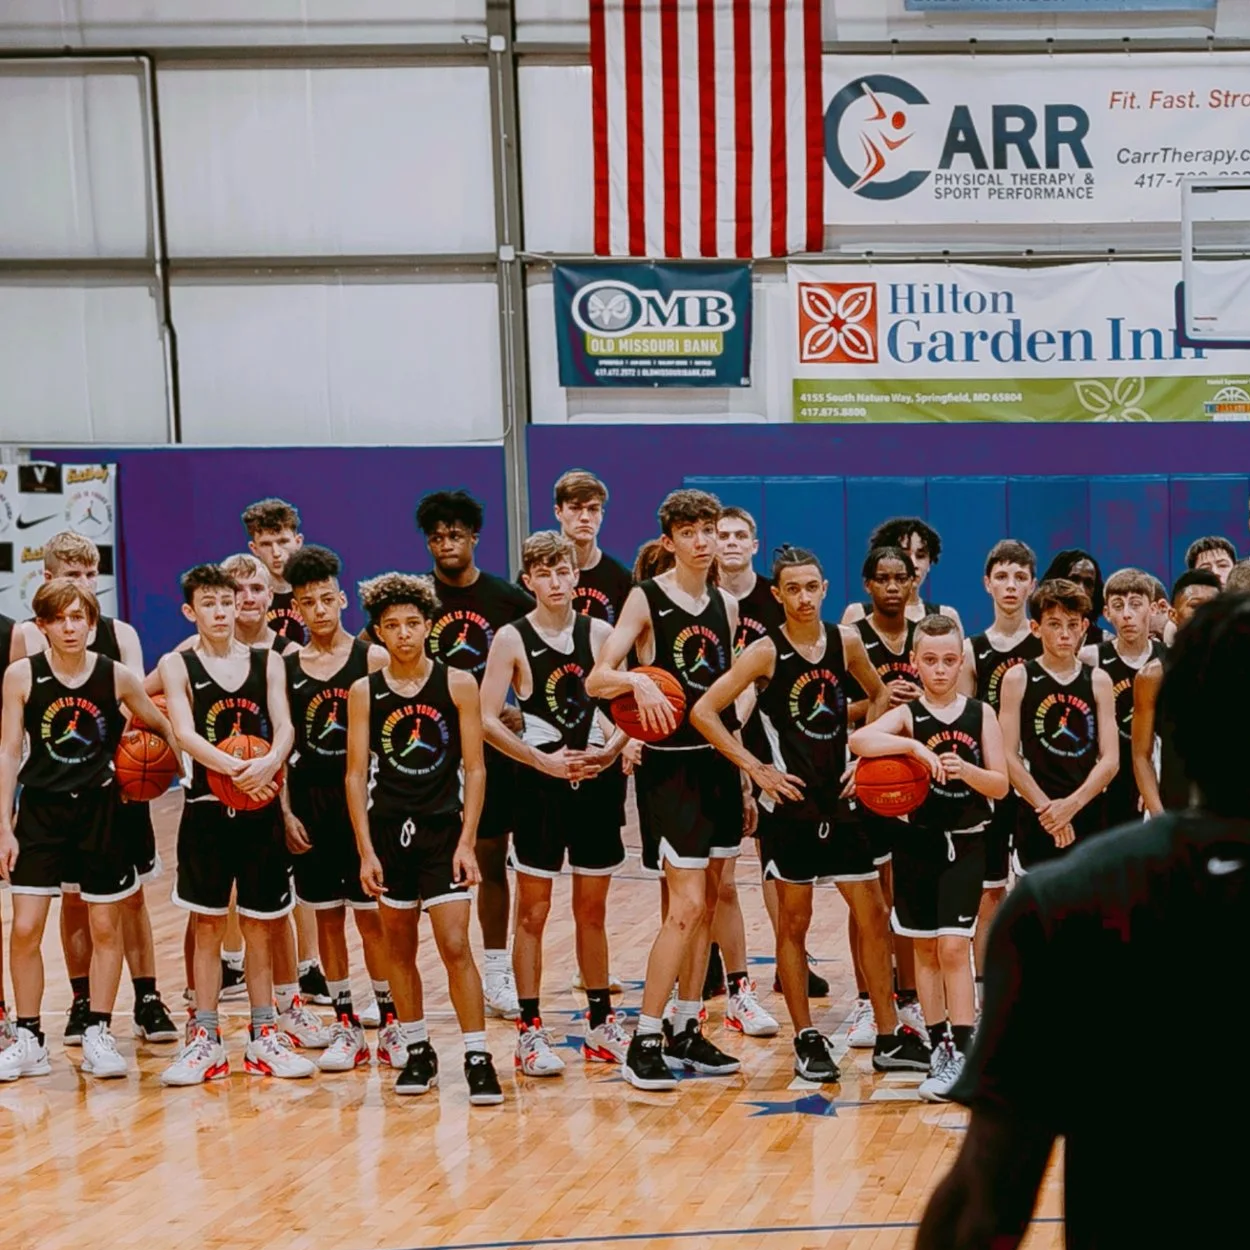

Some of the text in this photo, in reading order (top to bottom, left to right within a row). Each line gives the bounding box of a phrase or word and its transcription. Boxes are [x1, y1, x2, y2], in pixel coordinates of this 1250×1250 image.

[1109, 91, 1141, 110] Fit.
[1149, 90, 1200, 110] Fast.
[934, 173, 1095, 186] PHYSICAL THERAPY &
[934, 187, 1094, 200] SPORT PERFORMANCE
[888, 283, 1017, 315] Hilton
[578, 285, 730, 332] OMB
[591, 339, 718, 352] OLD MISSOURI BANK
[887, 318, 1097, 363] Garden
[800, 392, 1023, 404] 4155 South Nature Way, Springfield, MO 65804
